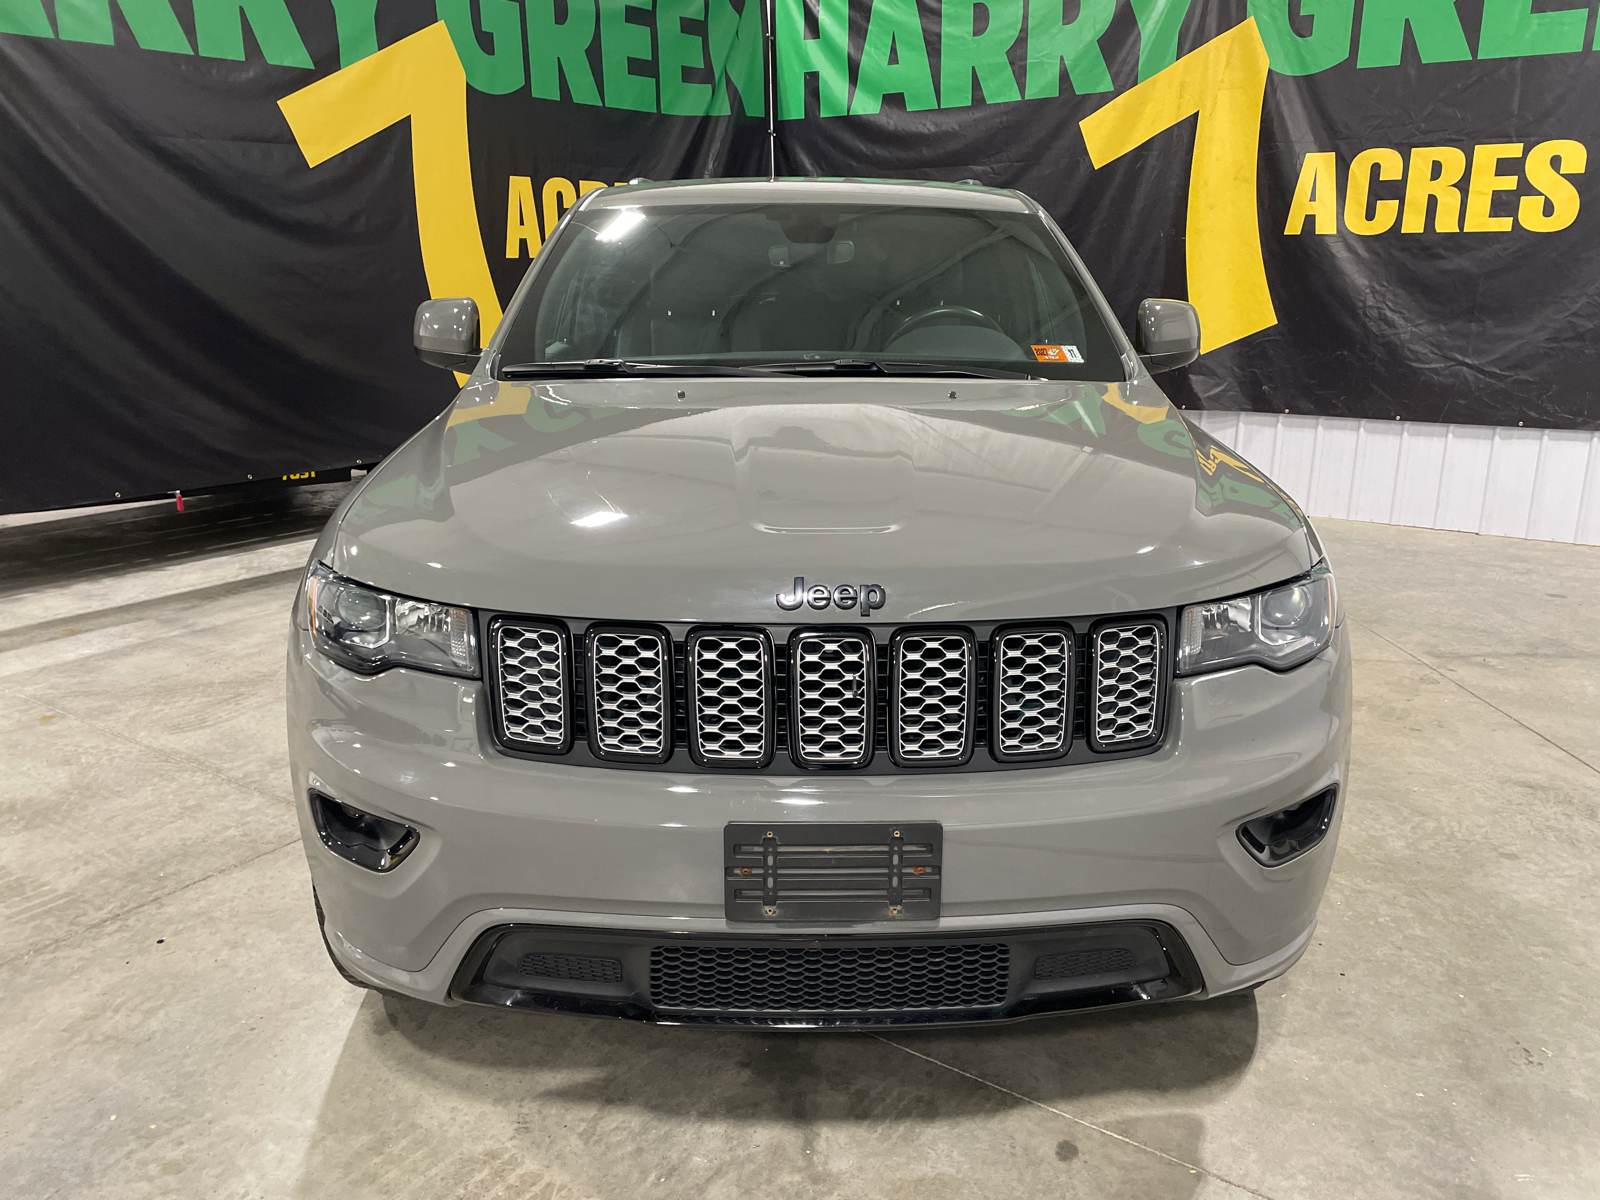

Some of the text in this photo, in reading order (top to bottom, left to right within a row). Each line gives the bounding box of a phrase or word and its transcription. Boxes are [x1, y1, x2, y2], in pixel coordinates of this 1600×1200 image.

[277, 20, 503, 388] 7
[1078, 15, 1278, 355] 7
[1283, 138, 1588, 236] ACRES
[775, 576, 886, 617] Jeep
